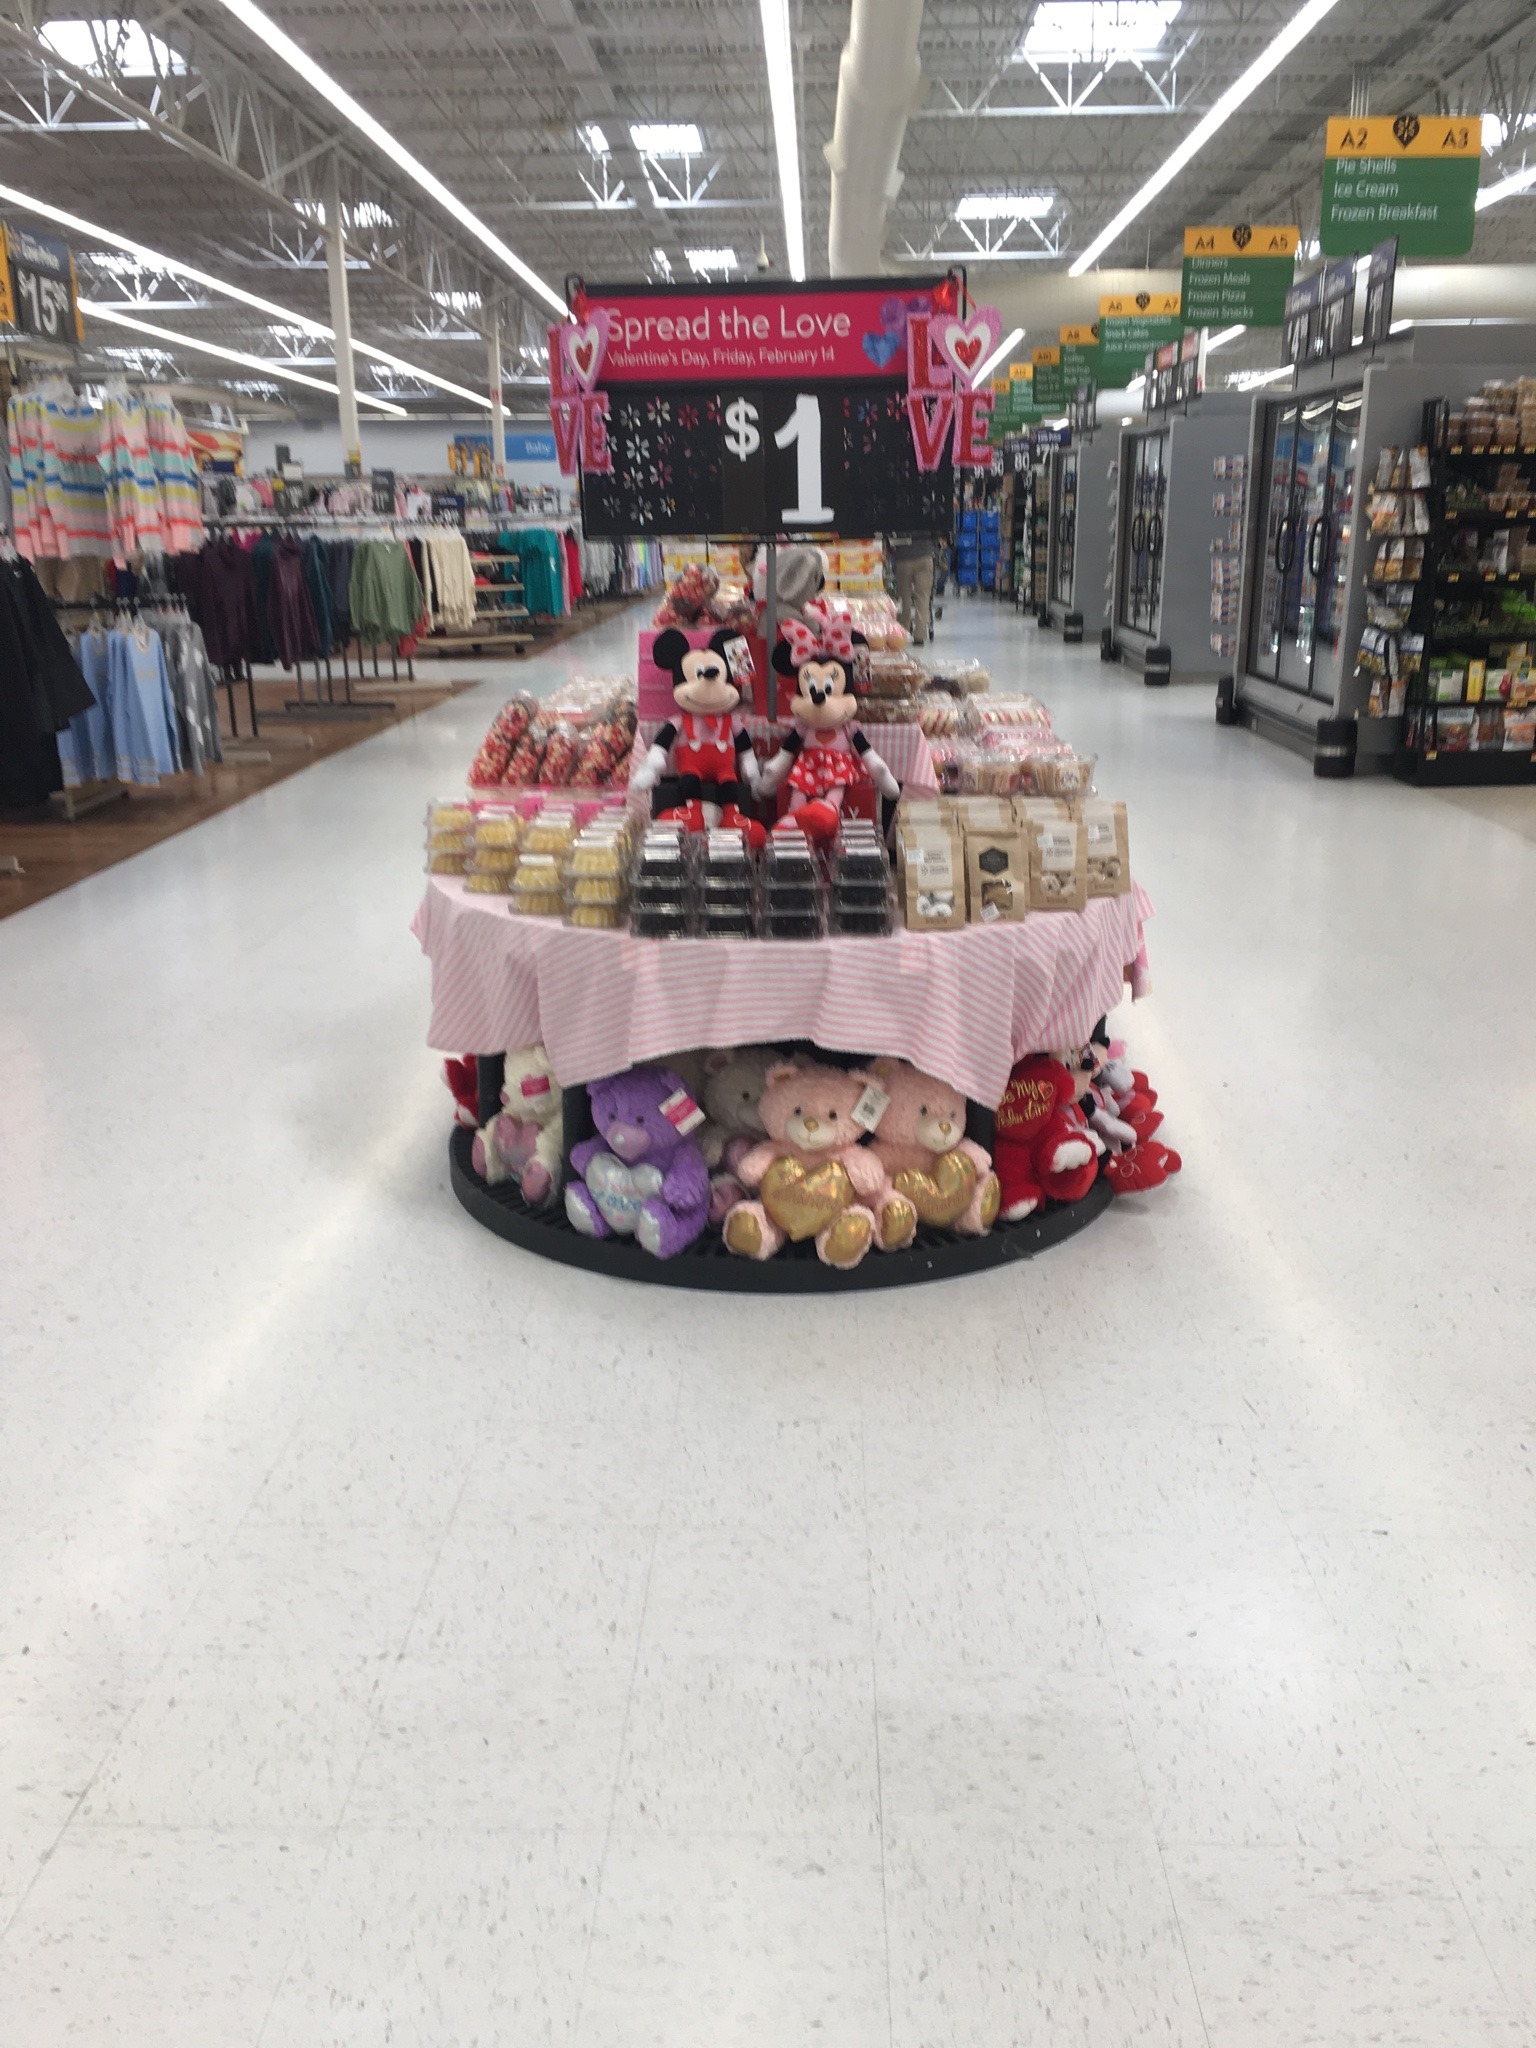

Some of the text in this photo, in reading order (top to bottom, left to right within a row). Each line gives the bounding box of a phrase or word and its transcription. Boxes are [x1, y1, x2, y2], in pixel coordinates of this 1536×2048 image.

[1340, 128, 1368, 150] A2
[1442, 127, 1469, 150] A3
[1336, 157, 1397, 175] Pie Shells
[1334, 180, 1399, 198] Ice Cream
[1331, 202, 1439, 221] Frozen Breakfast
[607, 304, 851, 350] Spread the Love
[607, 345, 835, 369] Valentine's Day, Friday, February 14
